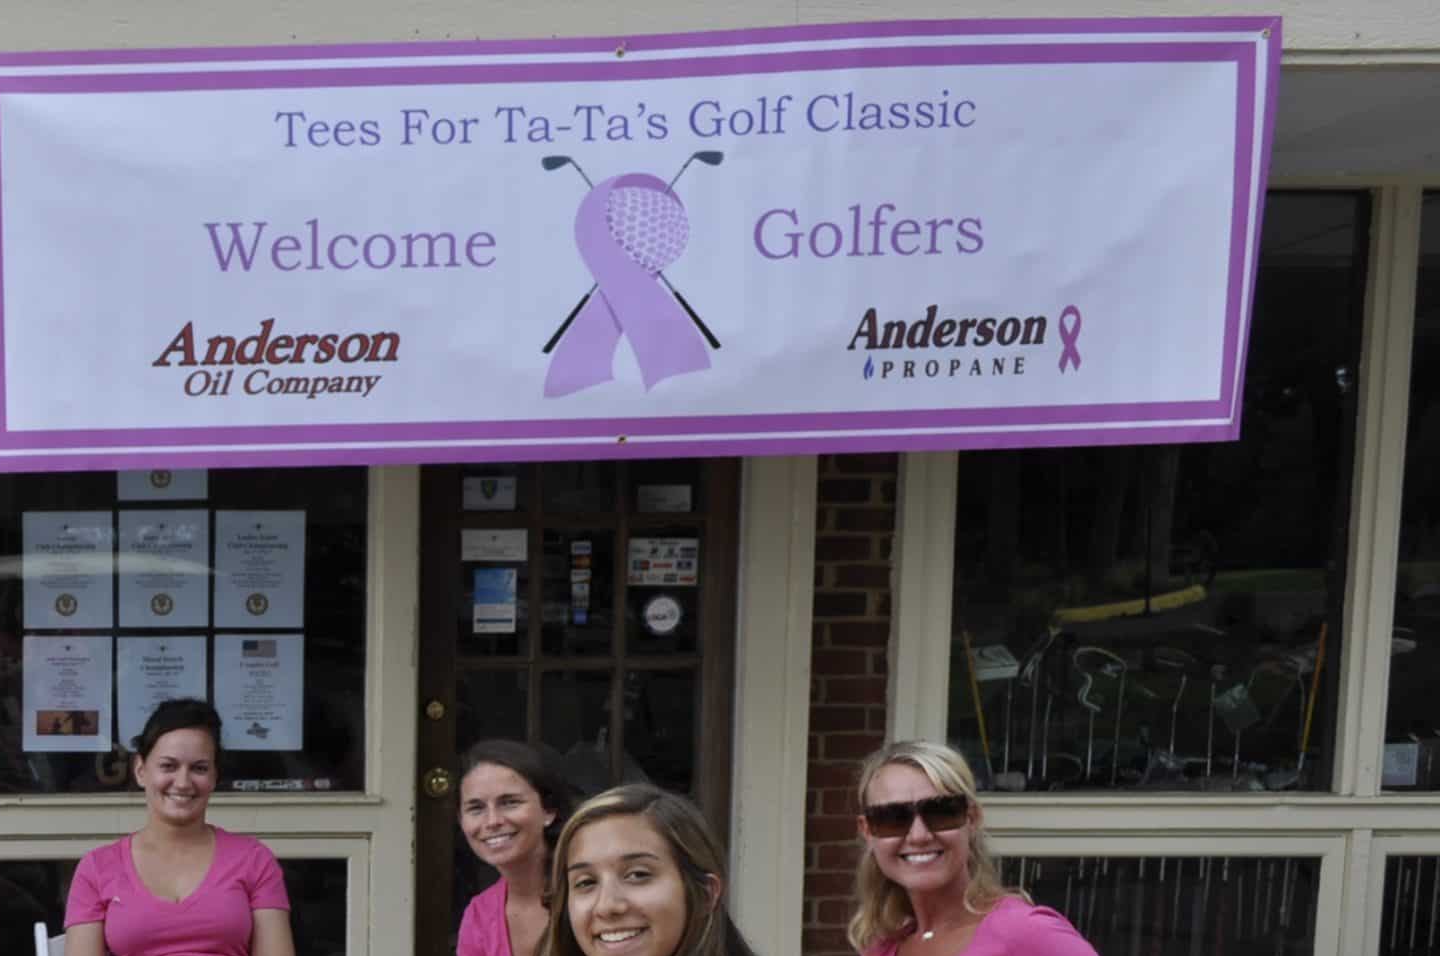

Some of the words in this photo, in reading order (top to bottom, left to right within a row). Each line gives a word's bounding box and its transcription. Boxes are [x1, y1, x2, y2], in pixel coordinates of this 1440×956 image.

[274, 111, 381, 148] Tees
[400, 109, 480, 145] For
[494, 102, 669, 143] Ta-Ta's
[688, 95, 793, 138] Golf
[806, 89, 977, 133] Classic
[203, 218, 497, 273] Welcome
[753, 203, 984, 260] Golfers
[151, 317, 401, 367] Anderson
[846, 304, 1047, 351] Anderson
[183, 369, 233, 397] Oil
[243, 369, 382, 400] Company
[880, 356, 1026, 379] PROPANE
